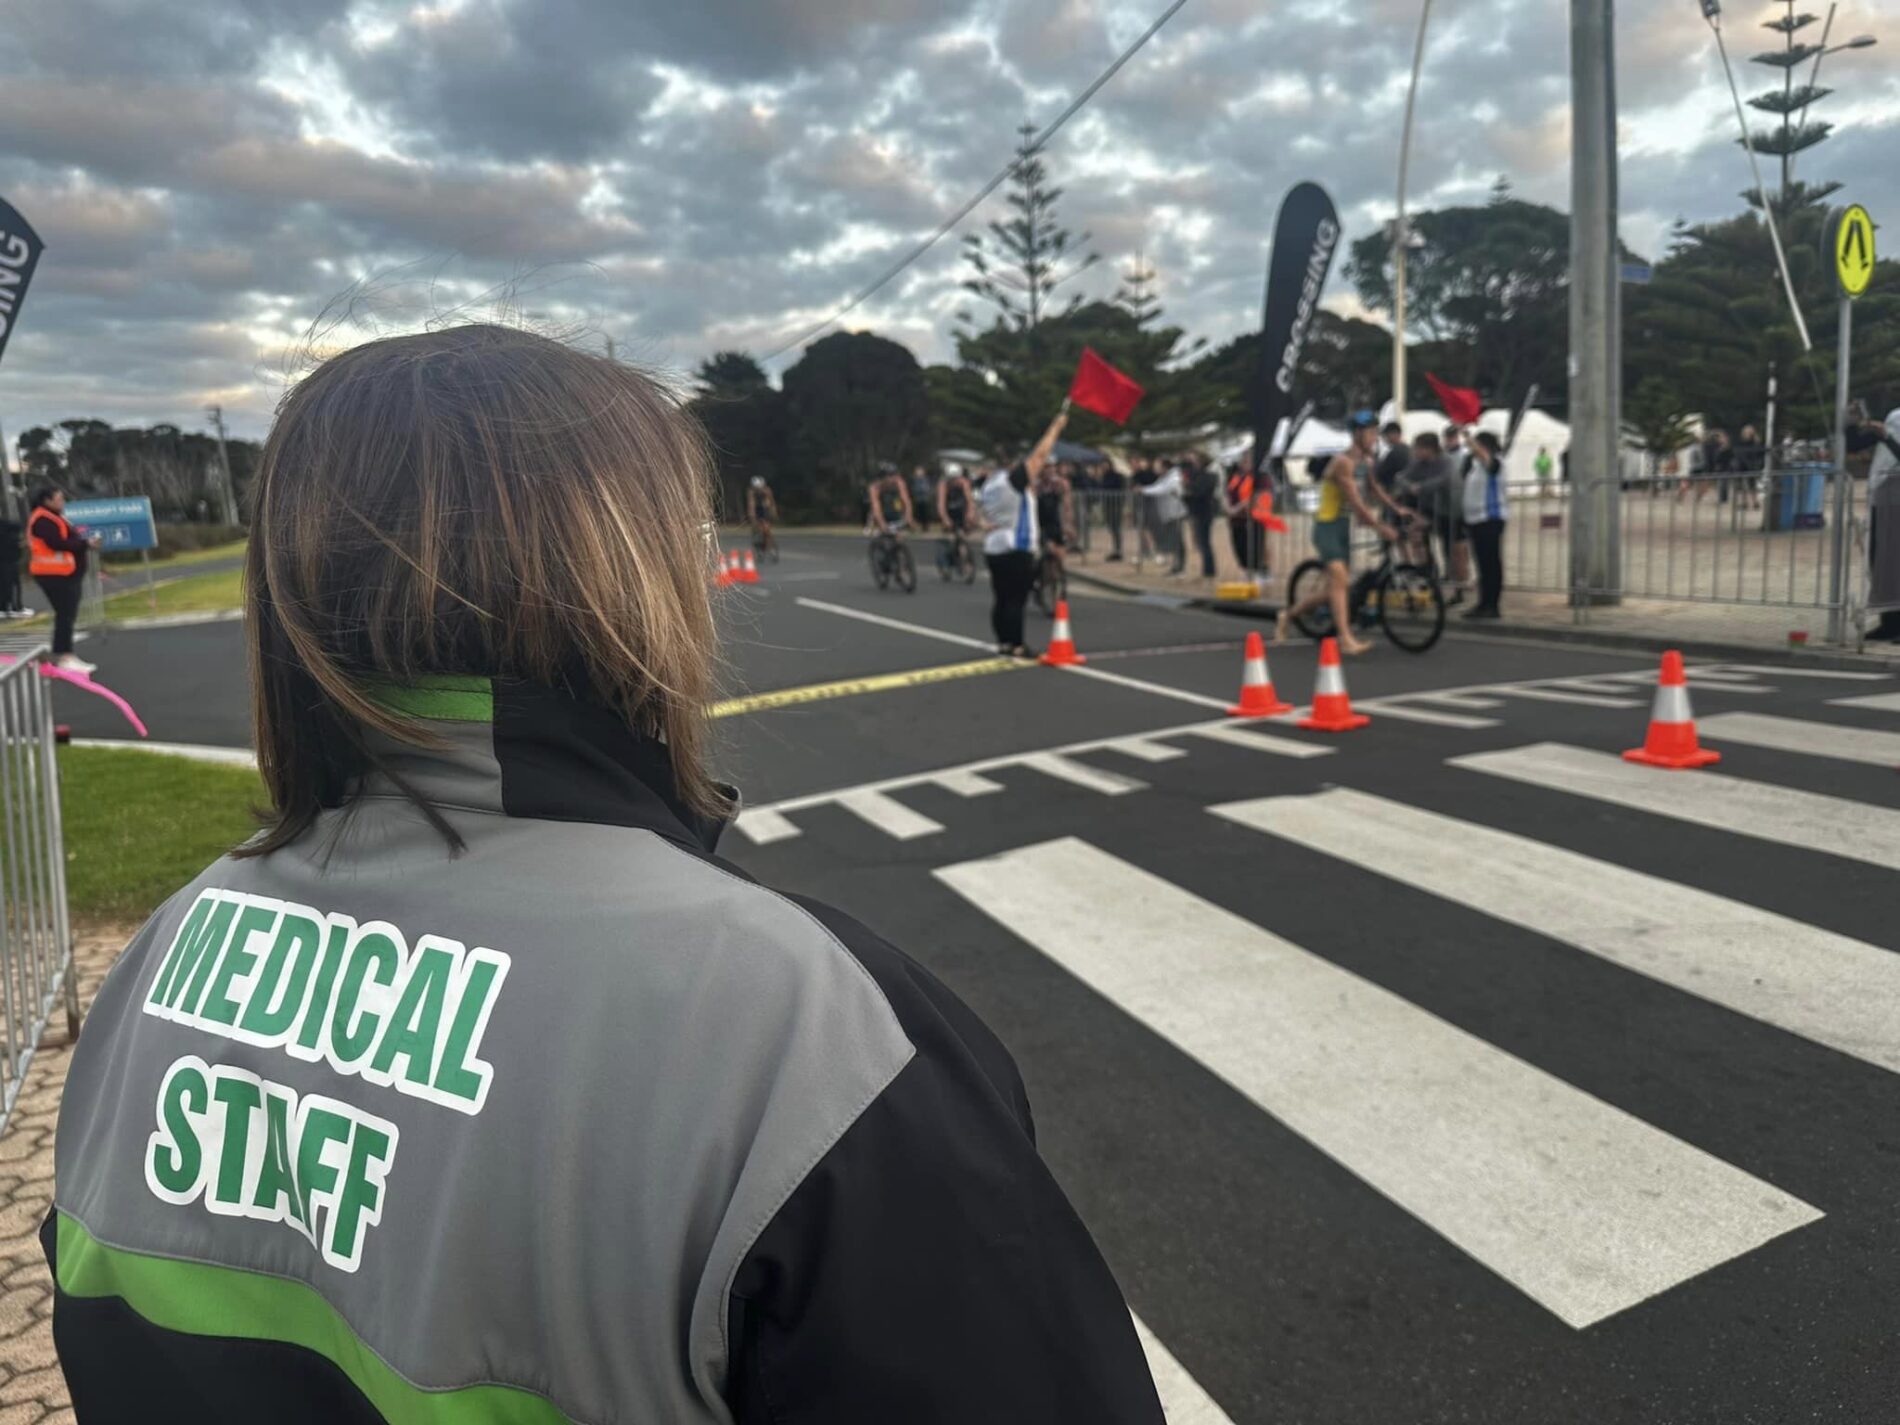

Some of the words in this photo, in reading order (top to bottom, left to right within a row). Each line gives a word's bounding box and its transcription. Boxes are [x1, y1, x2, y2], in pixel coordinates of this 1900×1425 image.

[1277, 217, 1337, 392] CROSSING
[143, 888, 511, 1115] MEDICAL
[145, 1055, 399, 1272] STAFF
